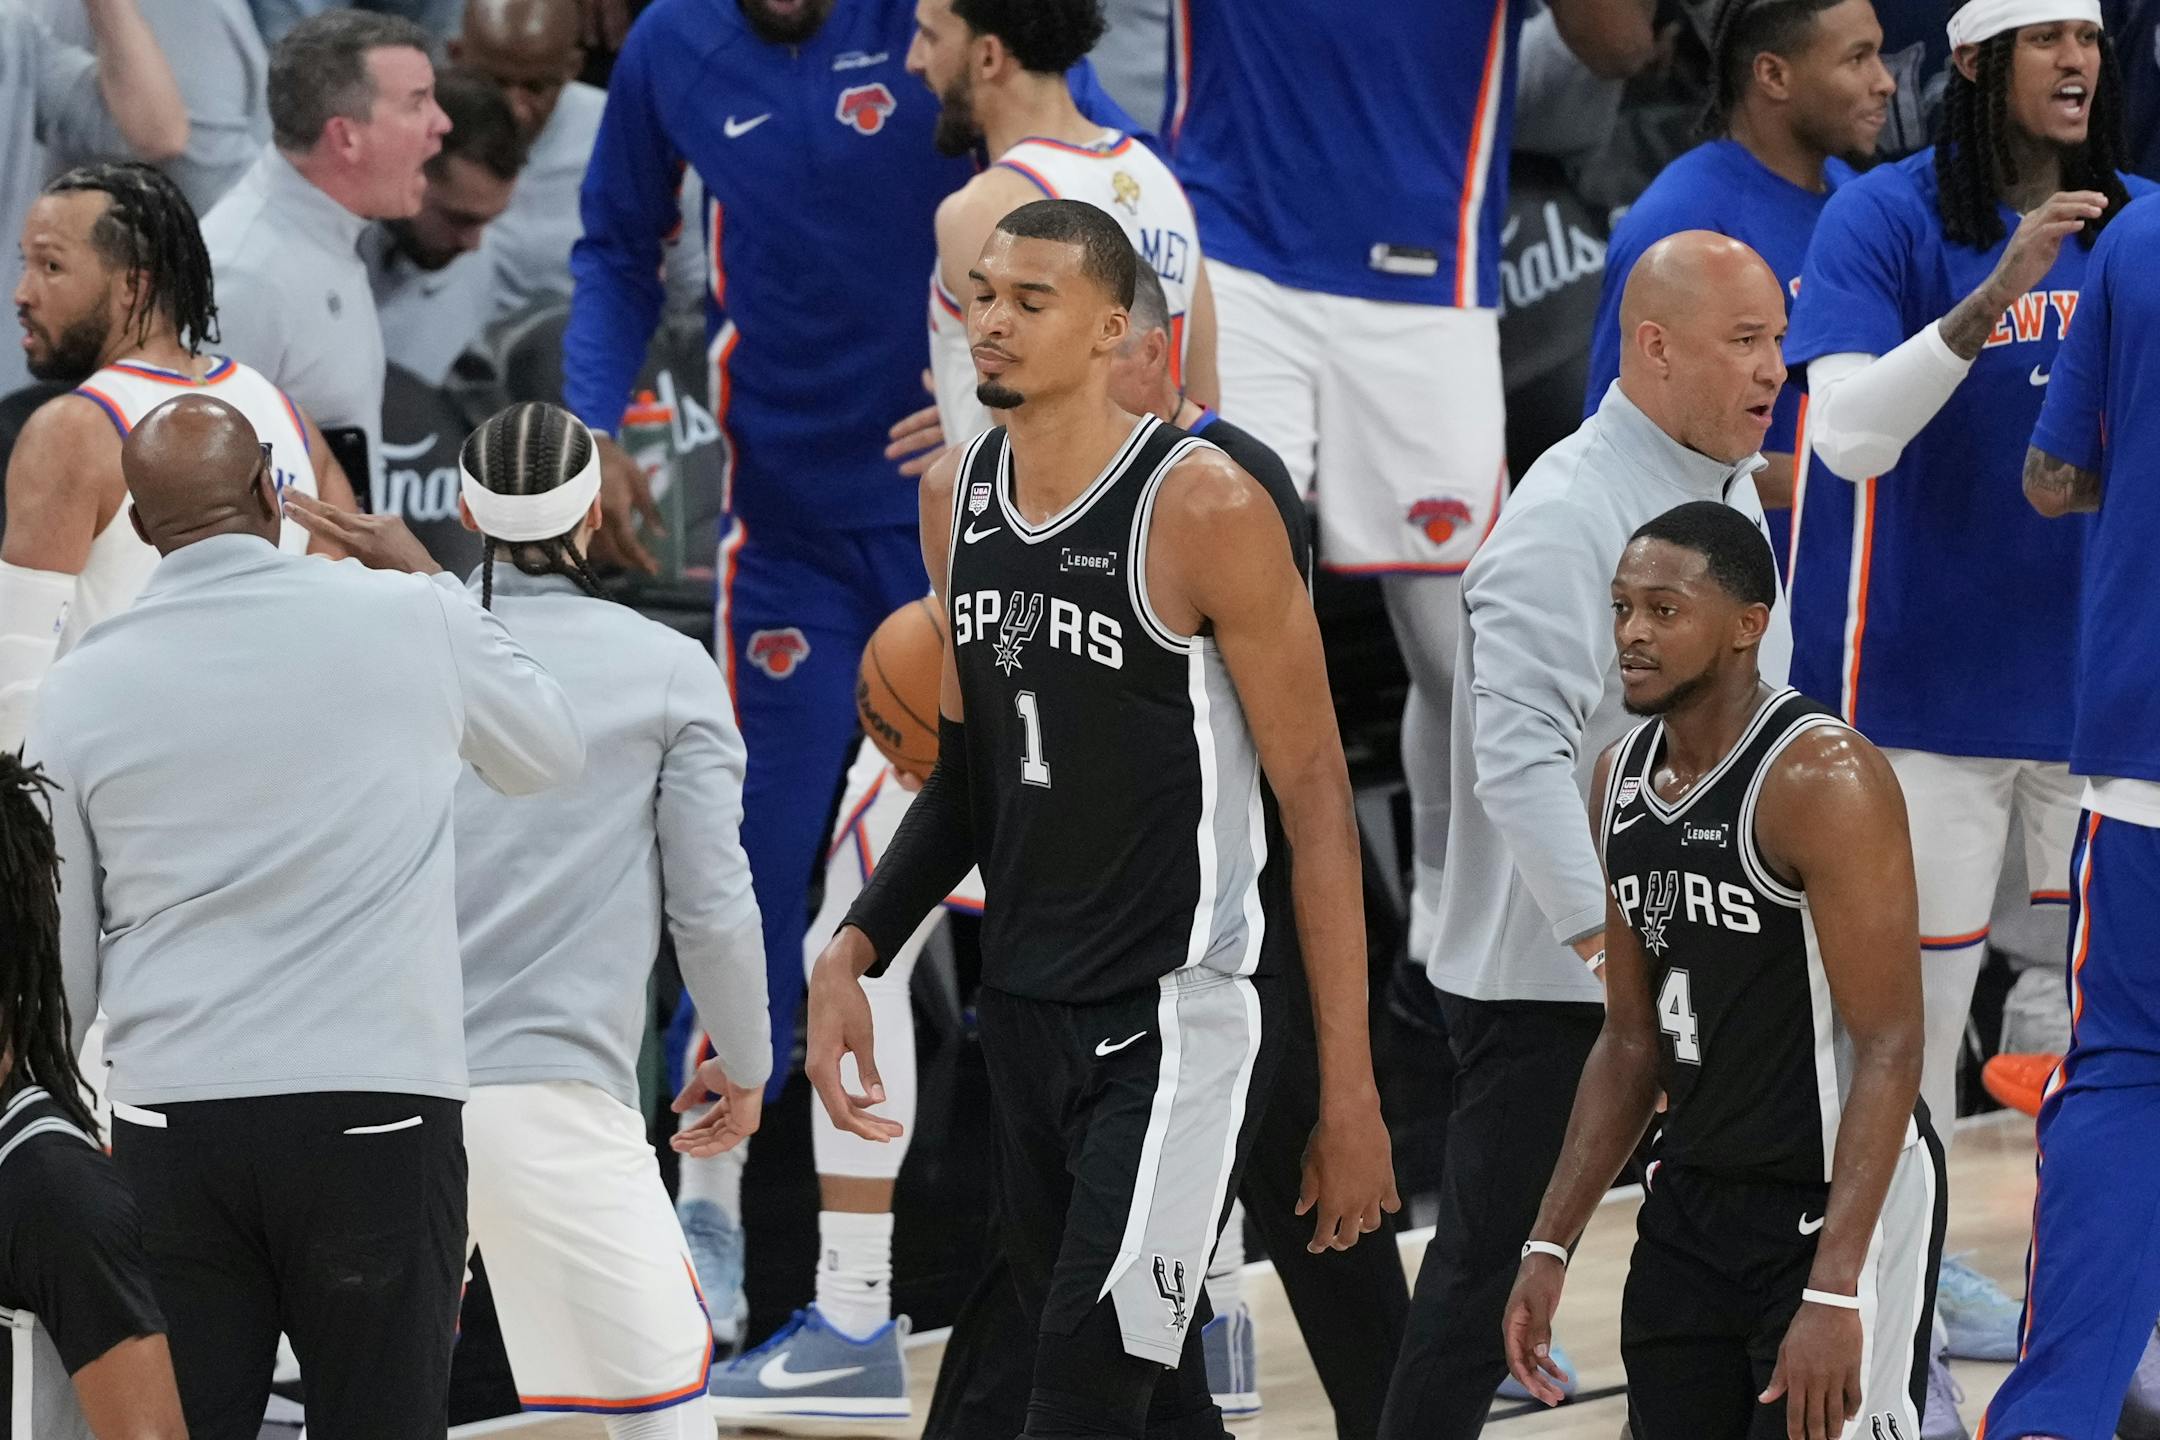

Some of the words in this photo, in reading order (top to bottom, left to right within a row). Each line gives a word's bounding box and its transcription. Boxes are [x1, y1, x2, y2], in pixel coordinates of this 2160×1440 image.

[1067, 554, 1110, 569] LEDGER
[954, 590, 1124, 677] SPURS
[1014, 689, 1052, 789] 1
[1686, 828, 1722, 841] LEDGER
[1610, 869, 1762, 957] PURS
[1656, 966, 1702, 1066] 4
